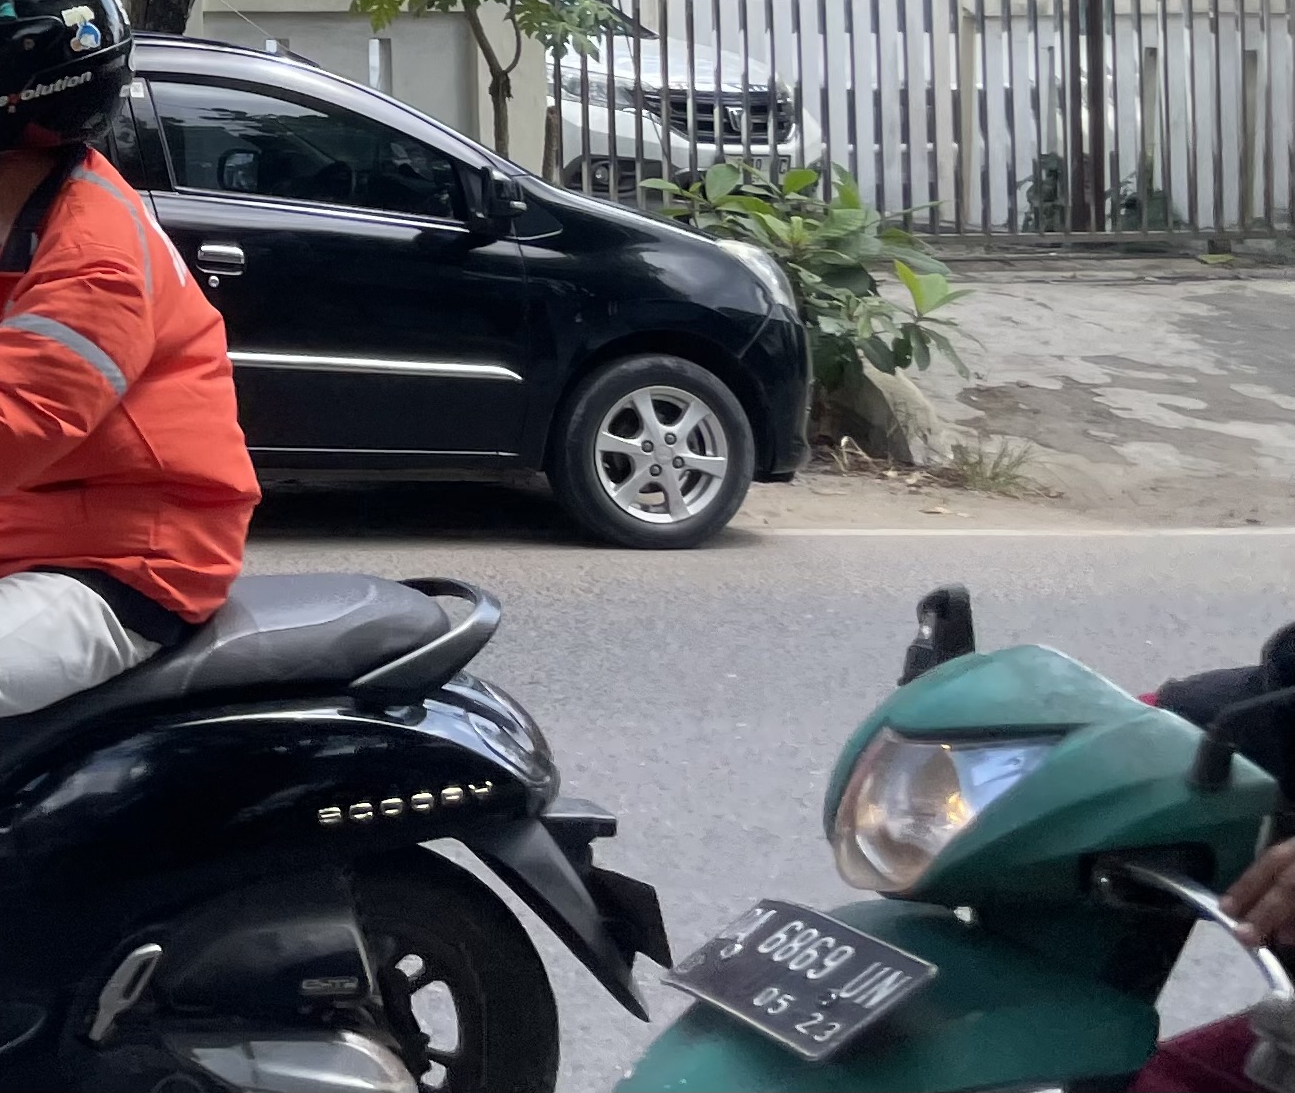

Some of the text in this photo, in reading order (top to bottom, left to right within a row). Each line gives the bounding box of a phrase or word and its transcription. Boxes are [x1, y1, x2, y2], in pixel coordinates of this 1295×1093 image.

[757, 920, 856, 980] 6869
[838, 961, 913, 1009] UN
[752, 986, 842, 1043] 05 23
